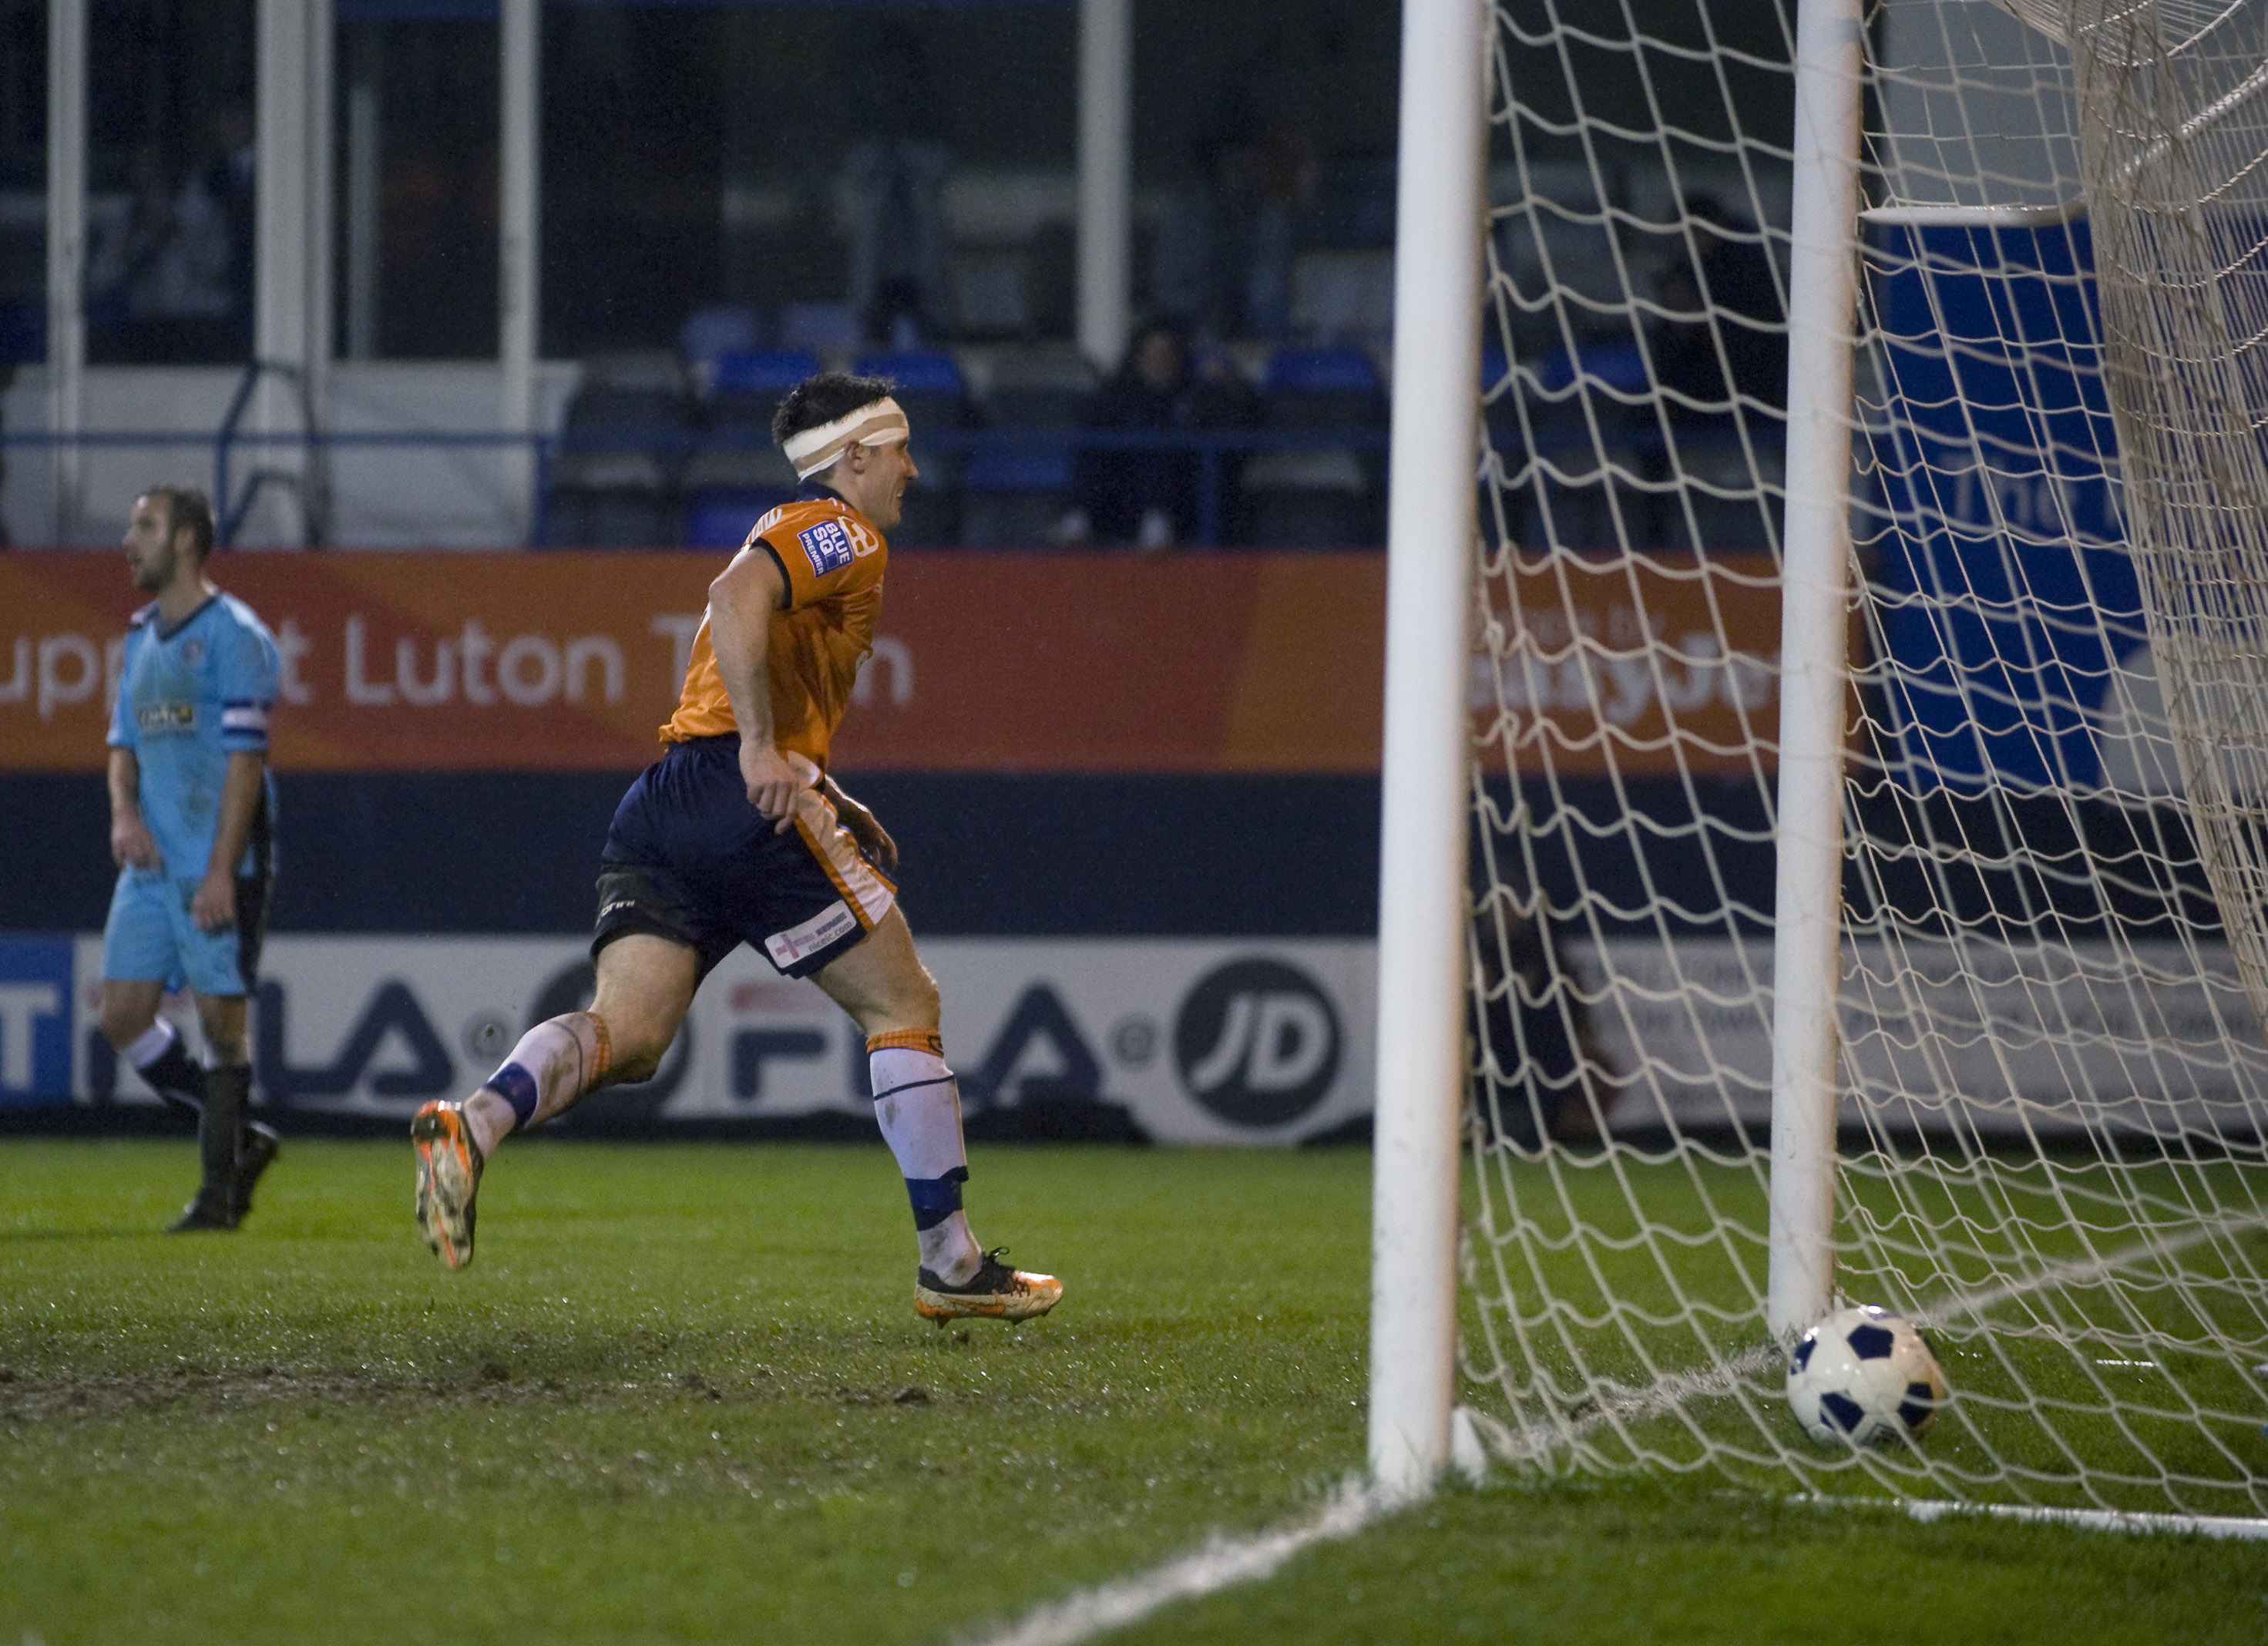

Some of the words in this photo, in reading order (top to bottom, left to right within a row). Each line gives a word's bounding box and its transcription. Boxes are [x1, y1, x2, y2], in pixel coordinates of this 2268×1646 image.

[801, 533, 825, 576] PREMIER
[812, 526, 835, 556] SQ
[825, 522, 850, 565] BLUE
[344, 613, 626, 706] Luton
[649, 614, 914, 709] Tn
[1191, 990, 1332, 1093] JD
